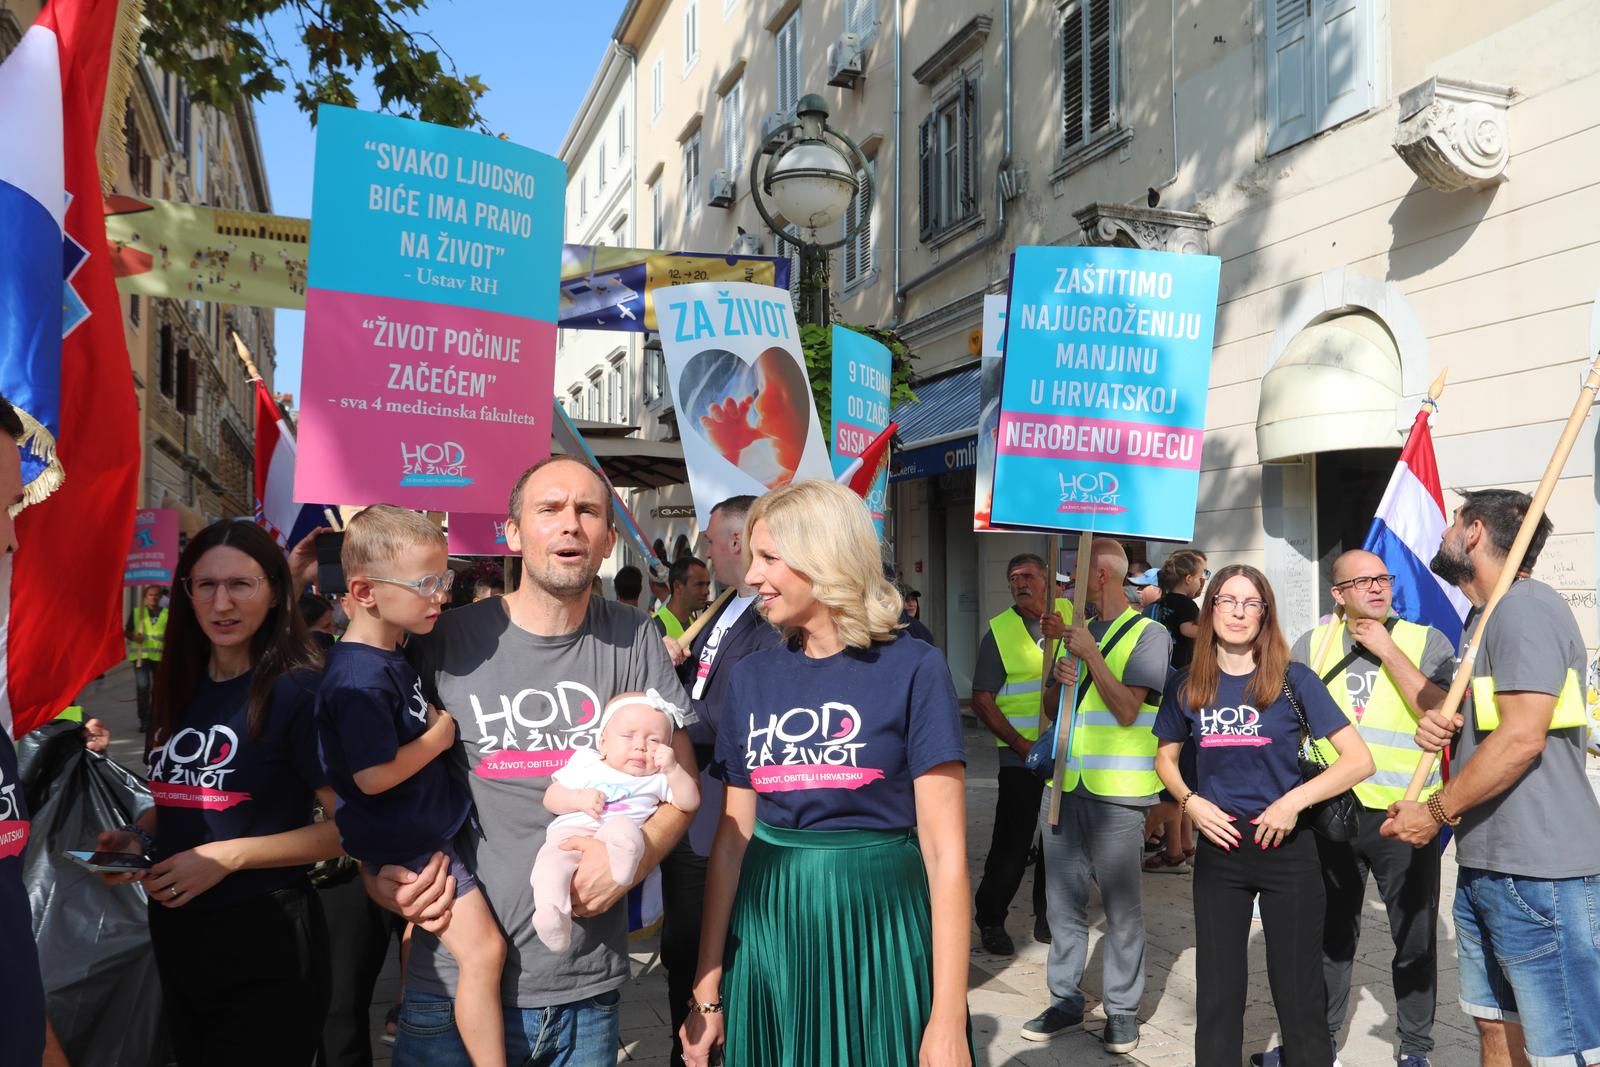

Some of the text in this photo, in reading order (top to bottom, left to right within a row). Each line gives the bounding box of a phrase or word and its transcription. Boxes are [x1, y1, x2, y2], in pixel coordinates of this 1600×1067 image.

[456, 156, 536, 200] LJUDSKO
[368, 183, 532, 239] BIĆE IMA PRAVO
[400, 230, 430, 260] NA
[417, 267, 466, 289] Ustav
[470, 275, 498, 295] RH
[1053, 263, 1173, 299] ZAŠTITIMO
[669, 290, 790, 343] ZA ŽIVOT
[1021, 302, 1202, 340] NAJUGROŽENIJU
[444, 328, 522, 363] POČINJE
[1055, 343, 1159, 375] MANJINU
[848, 360, 856, 383] 9
[340, 398, 368, 410] sva
[371, 396, 382, 411] 4
[386, 400, 477, 420] medicinska
[479, 405, 535, 425] fakulteta
[848, 395, 864, 420] OD
[1030, 379, 1177, 415] U HRVATSKOJ
[401, 441, 465, 466] HOD
[839, 428, 865, 454] SISA
[956, 440, 978, 468] mli
[1005, 421, 1195, 461] NEROĐENU DJECU
[402, 462, 467, 477] ZA ŽIVOT
[1058, 471, 1119, 495] HOD
[1060, 490, 1121, 505] ZA ŽIVOT
[470, 680, 601, 738] HOD
[1200, 704, 1260, 728] HOD
[477, 728, 521, 754] ZA
[748, 702, 862, 753] HOD
[1200, 723, 1263, 737] ZA ŽIVOT
[487, 762, 499, 770] ZA
[499, 760, 527, 770] ŽIVOT,
[527, 760, 559, 769] OBITELJ
[745, 742, 867, 770] ZA ŽIVOT
[168, 764, 237, 791] ŽIVOT
[784, 774, 815, 782] OBITELJ
[820, 772, 863, 780] HRVATSKU
[0, 828, 24, 846] VATSKU
